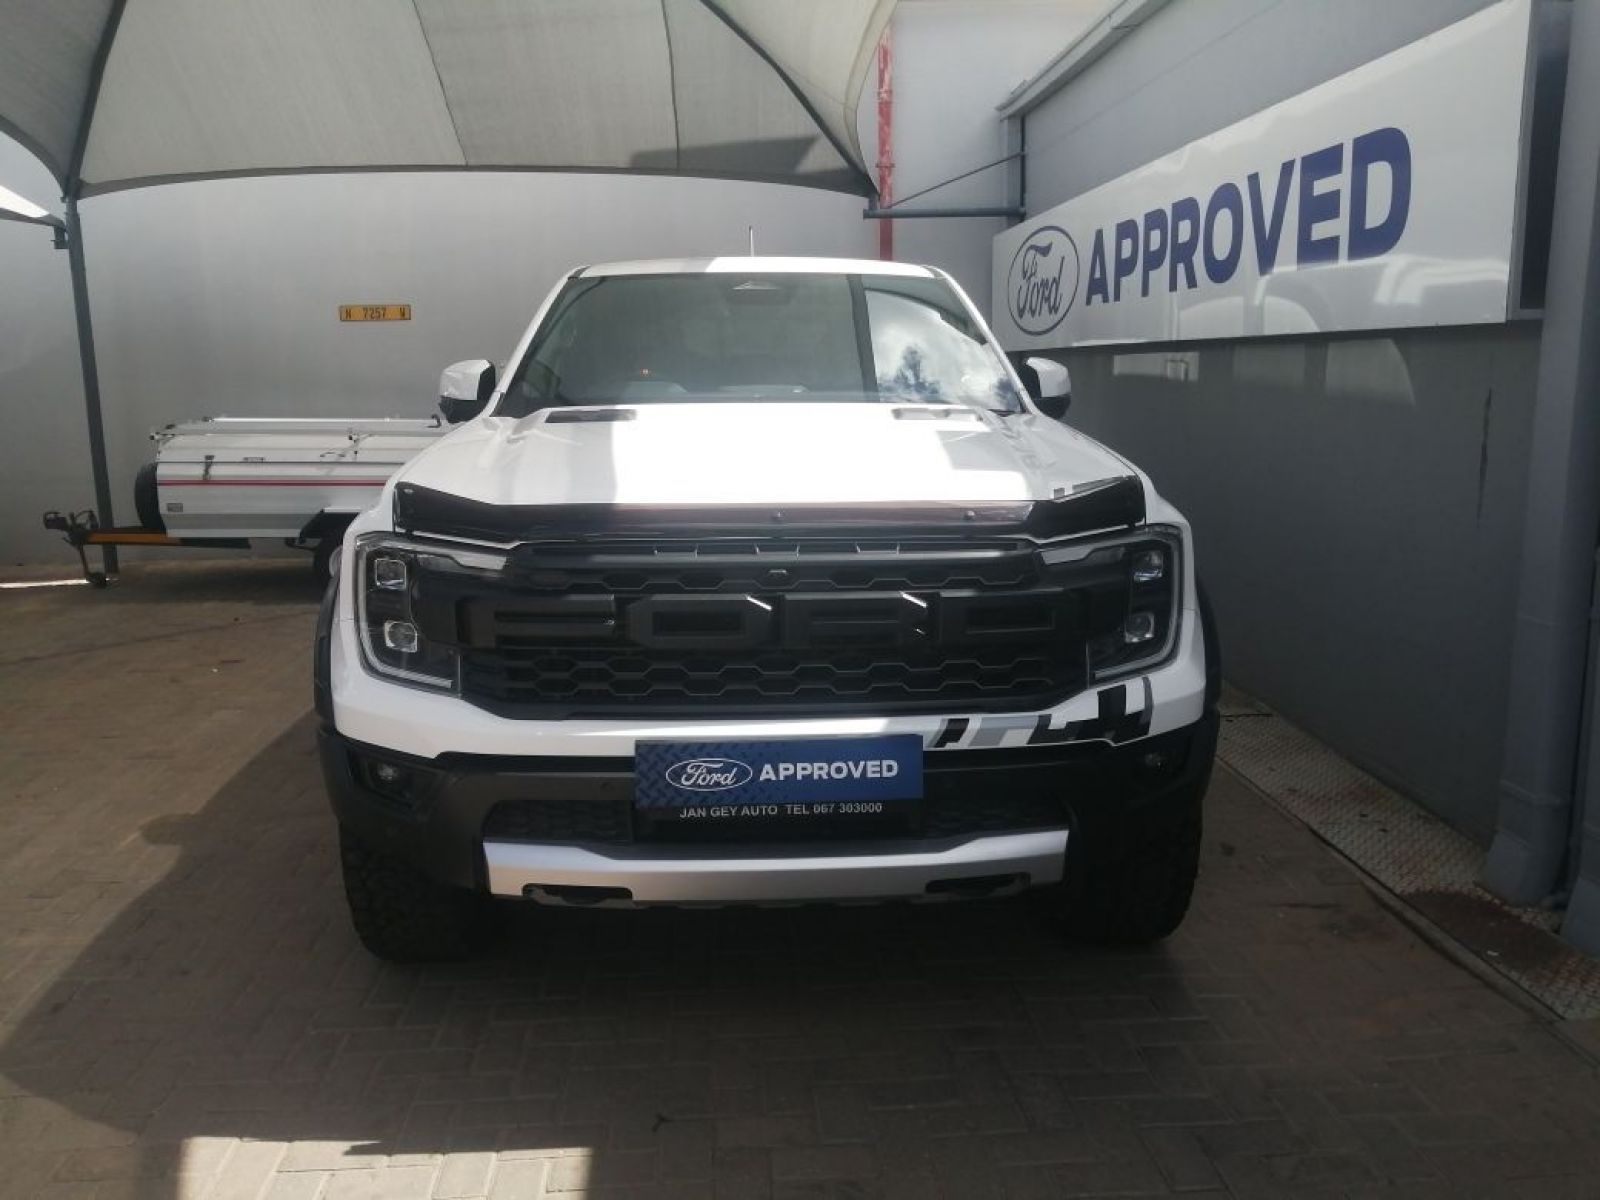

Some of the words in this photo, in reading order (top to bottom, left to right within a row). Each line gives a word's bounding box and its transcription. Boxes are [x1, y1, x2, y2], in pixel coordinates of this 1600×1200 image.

[1085, 126, 1412, 307] APPROVED
[680, 761, 738, 786] Ford
[759, 759, 899, 781] APPROVED
[679, 807, 707, 819] JAN
[710, 805, 738, 817] GEY
[741, 804, 778, 816] AUTO
[786, 803, 810, 815] TEL
[813, 802, 835, 815] 067
[839, 802, 883, 814] 303000
